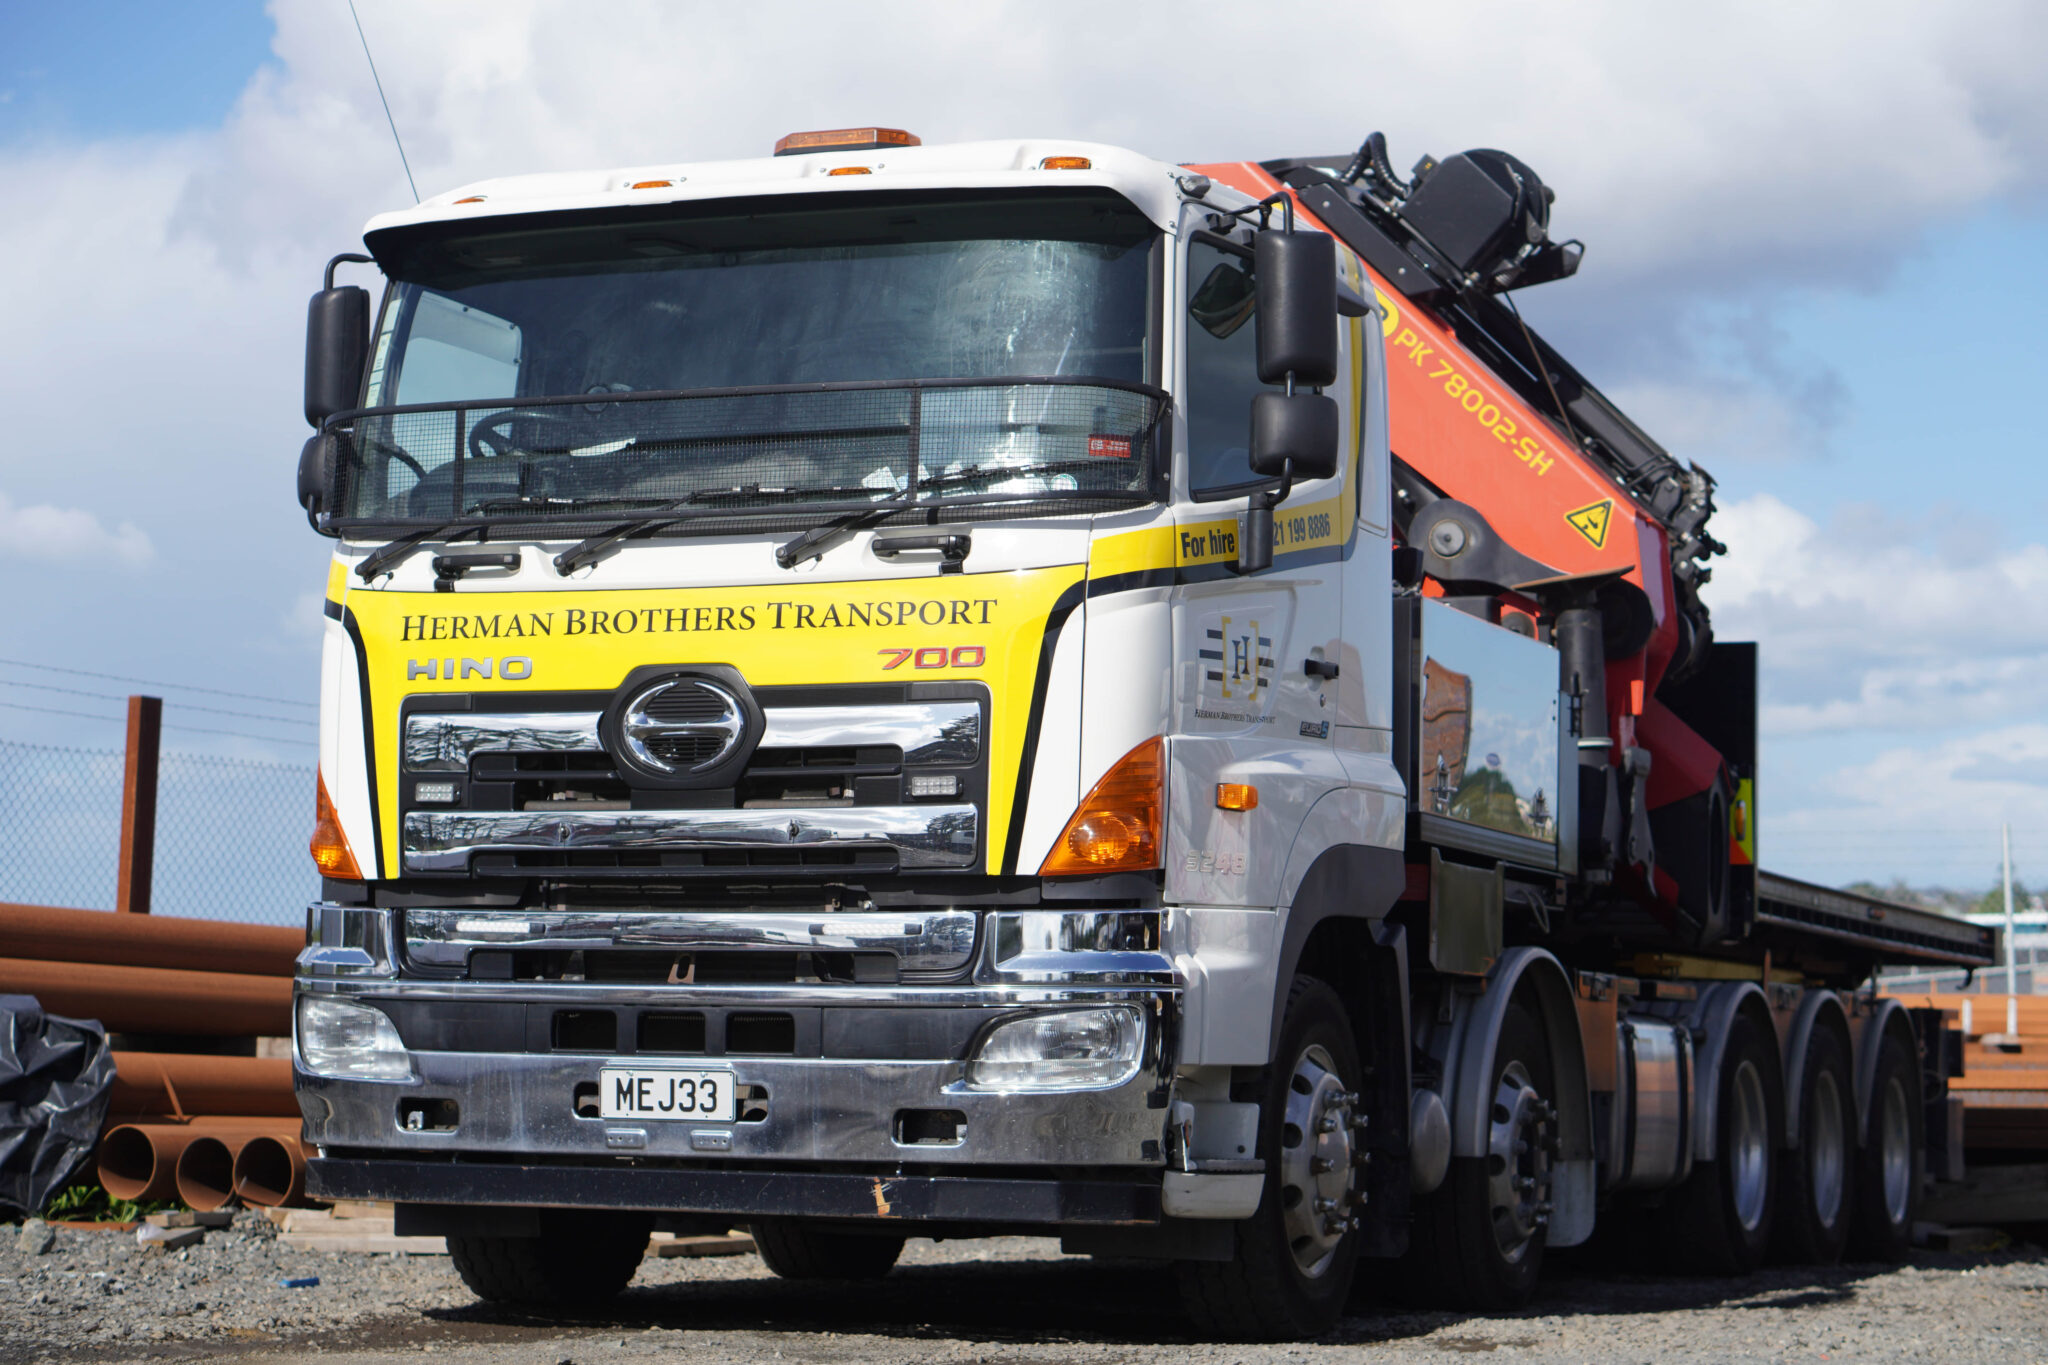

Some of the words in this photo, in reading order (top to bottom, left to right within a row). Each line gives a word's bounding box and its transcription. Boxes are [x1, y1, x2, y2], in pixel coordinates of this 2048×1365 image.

[1394, 328, 1433, 367] PK
[1429, 359, 1555, 476] 78002-SH
[1180, 532, 1205, 558] For
[1209, 529, 1235, 555] hire
[1288, 518, 1306, 543] 199
[1307, 513, 1331, 540] 8886
[400, 612, 554, 641] HERMAN
[564, 605, 756, 635] BROTHERS
[767, 599, 998, 630] TRANSPORT
[407, 656, 533, 680] HINO
[878, 646, 986, 670] 700
[616, 1077, 718, 1112] MEJ33
